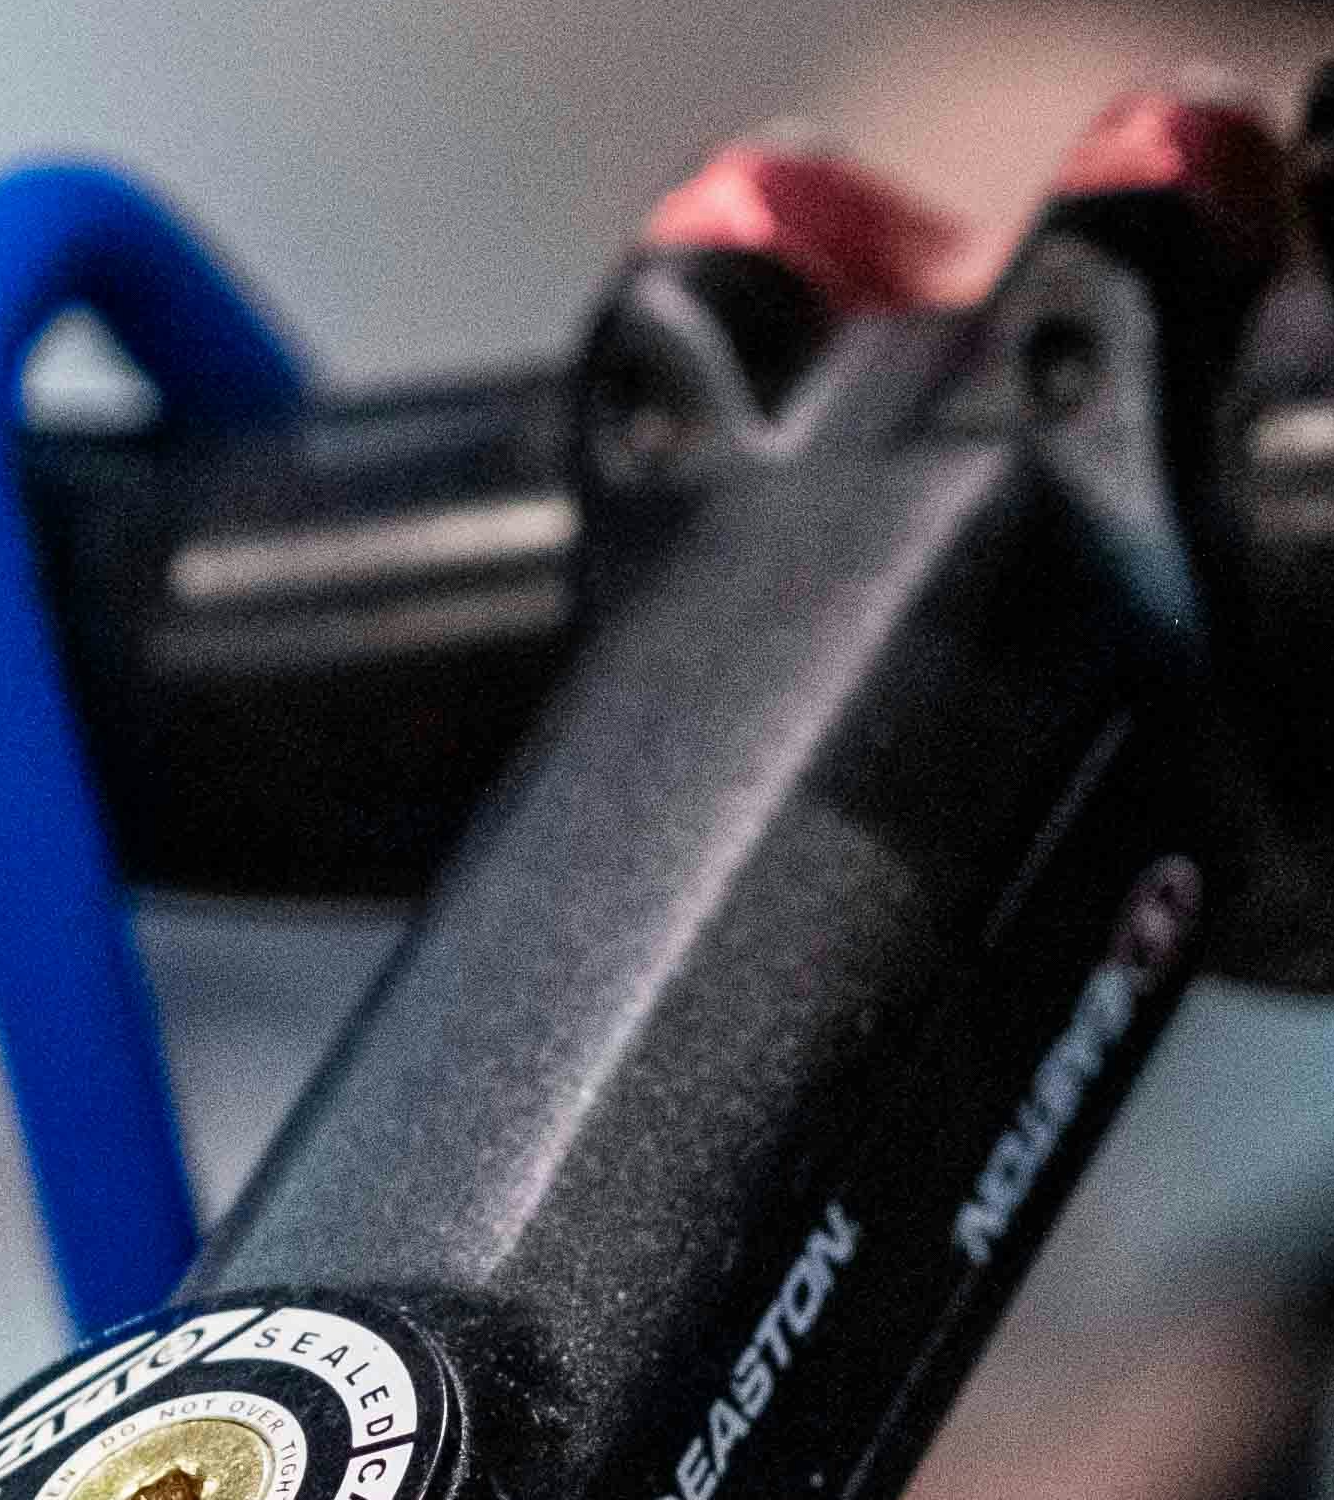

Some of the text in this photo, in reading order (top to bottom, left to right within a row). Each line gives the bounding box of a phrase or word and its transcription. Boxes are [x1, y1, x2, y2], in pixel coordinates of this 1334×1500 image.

[255, 1327, 393, 1436] SEALED
[100, 1423, 136, 1449] DO
[159, 1399, 212, 1420] NOT
[230, 1400, 284, 1433] OVER
